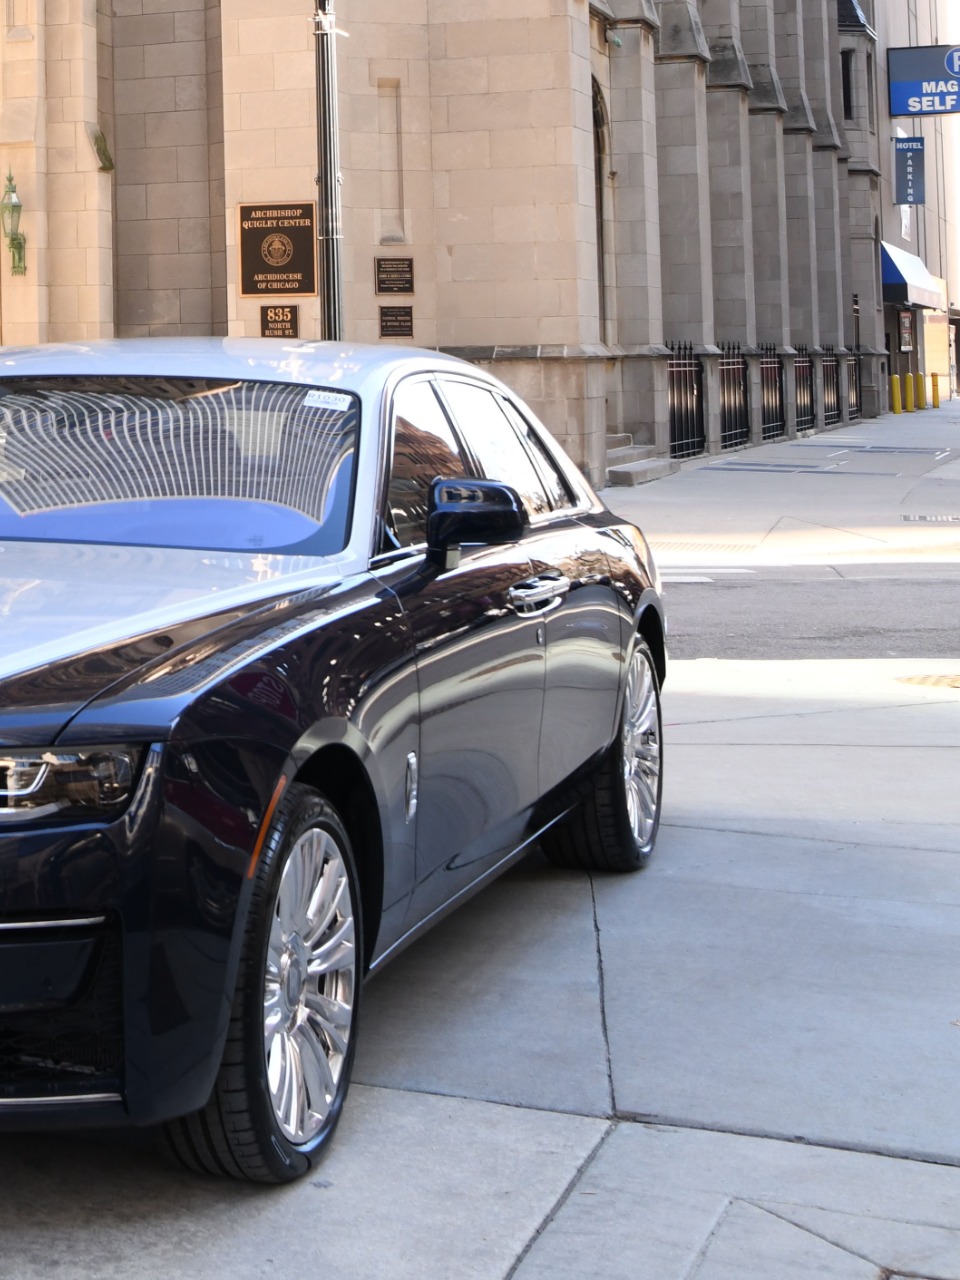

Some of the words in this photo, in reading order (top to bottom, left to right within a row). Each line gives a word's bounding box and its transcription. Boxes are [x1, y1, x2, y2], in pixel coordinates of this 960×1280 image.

[922, 80, 959, 94] MAG
[907, 95, 958, 112] SELF
[906, 152, 914, 202] PARKING
[251, 209, 302, 217] ARCHBISHOP
[242, 220, 277, 229] QUIGLEY
[278, 218, 311, 227] CENTER
[253, 273, 302, 281] ARCHDIOCESE
[267, 281, 299, 289] CHICAGO
[267, 307, 291, 322] 835
